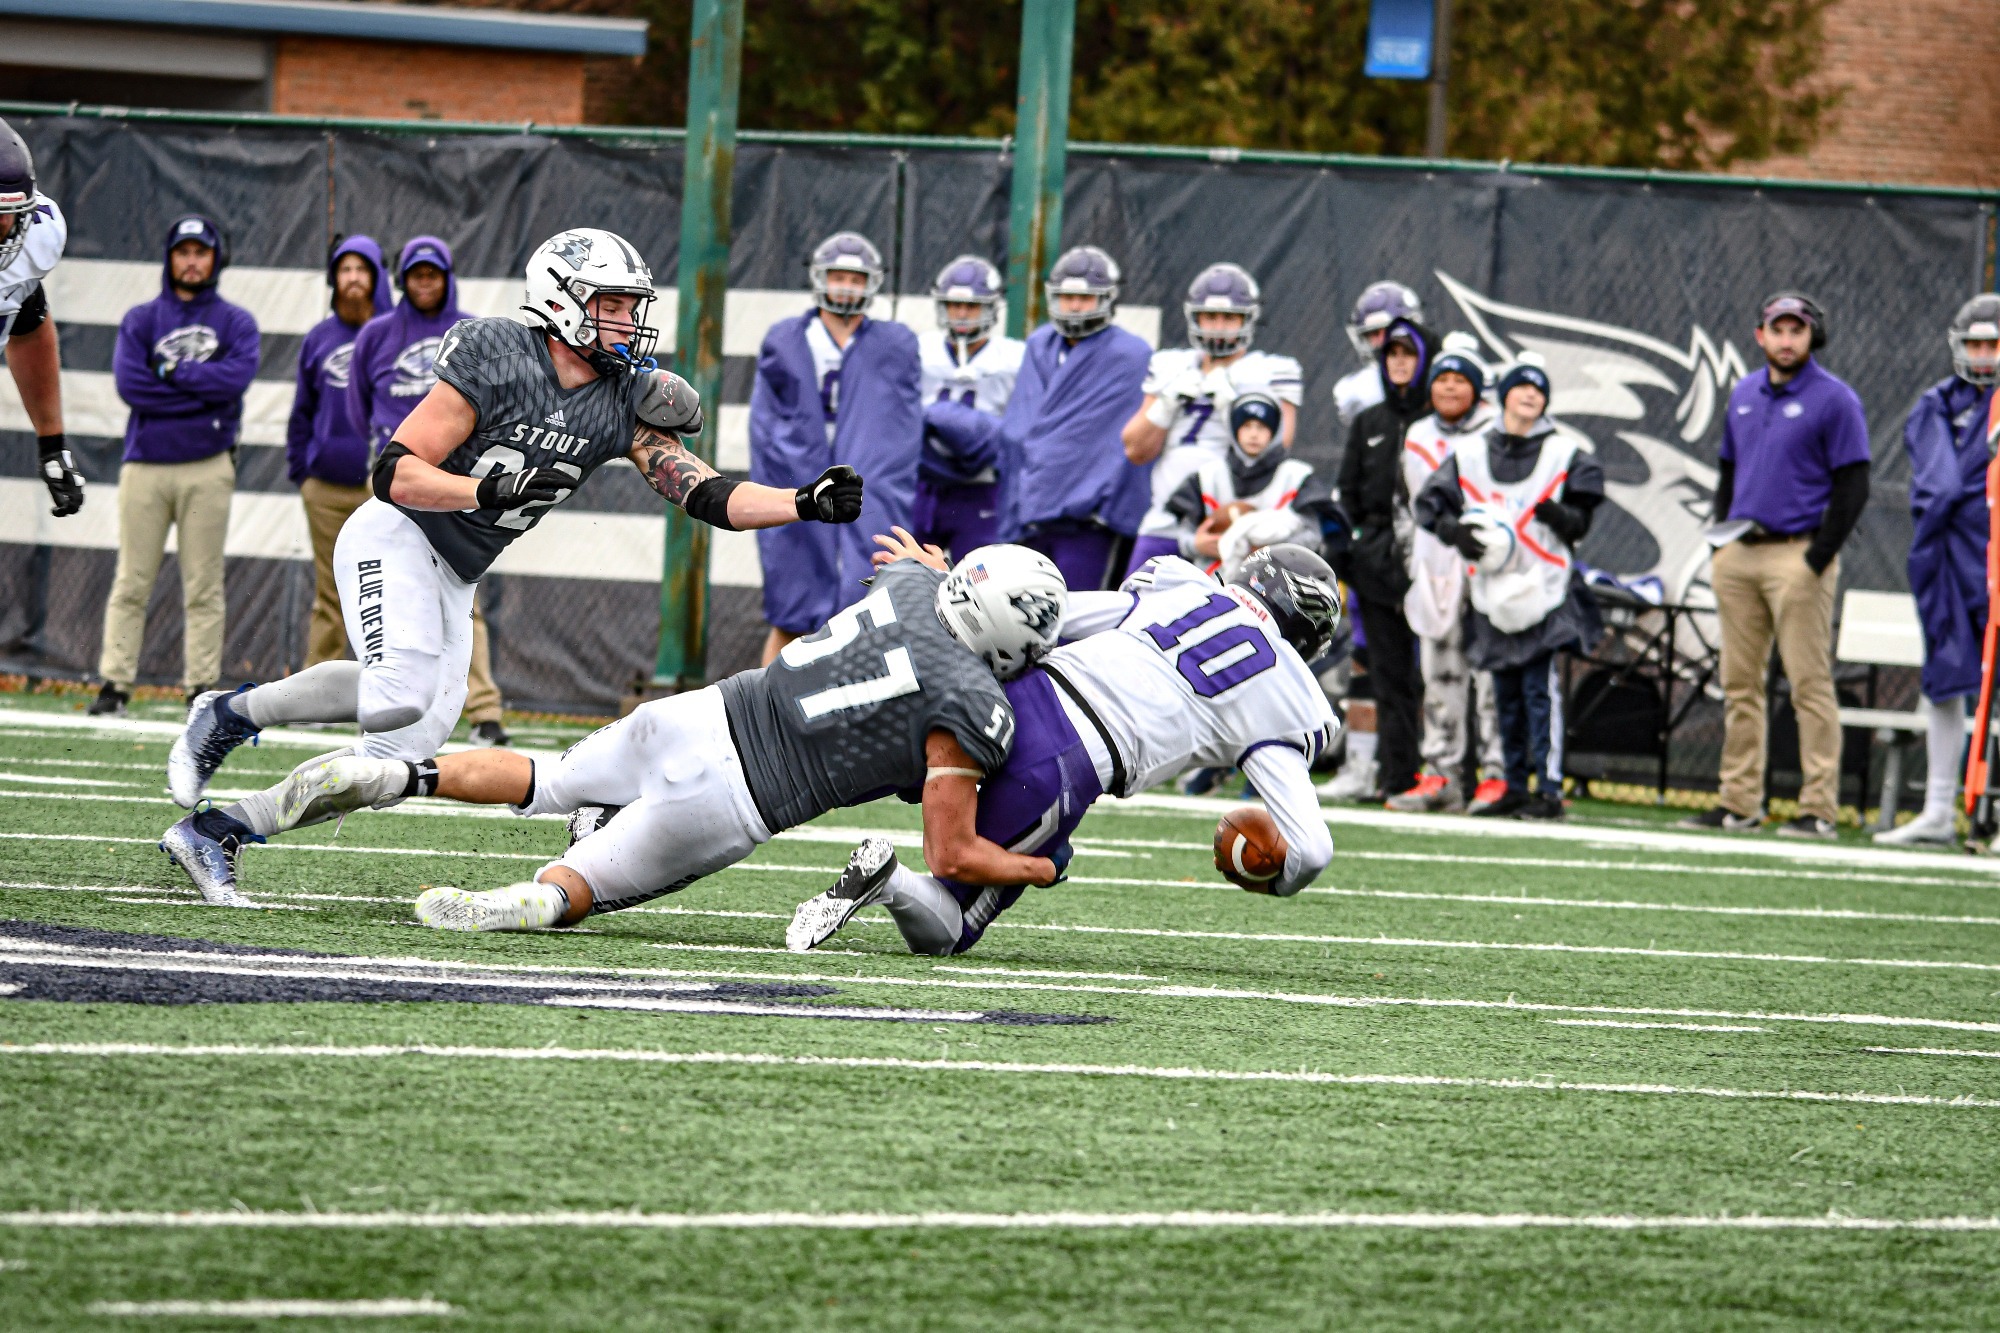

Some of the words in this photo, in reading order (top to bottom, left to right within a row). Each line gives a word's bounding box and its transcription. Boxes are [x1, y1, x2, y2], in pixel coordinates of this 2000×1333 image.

[509, 423, 590, 457] STOUT
[357, 559, 384, 606] BLUE
[780, 586, 921, 719] 57
[1141, 593, 1277, 699] 10
[983, 703, 1015, 751] 57
